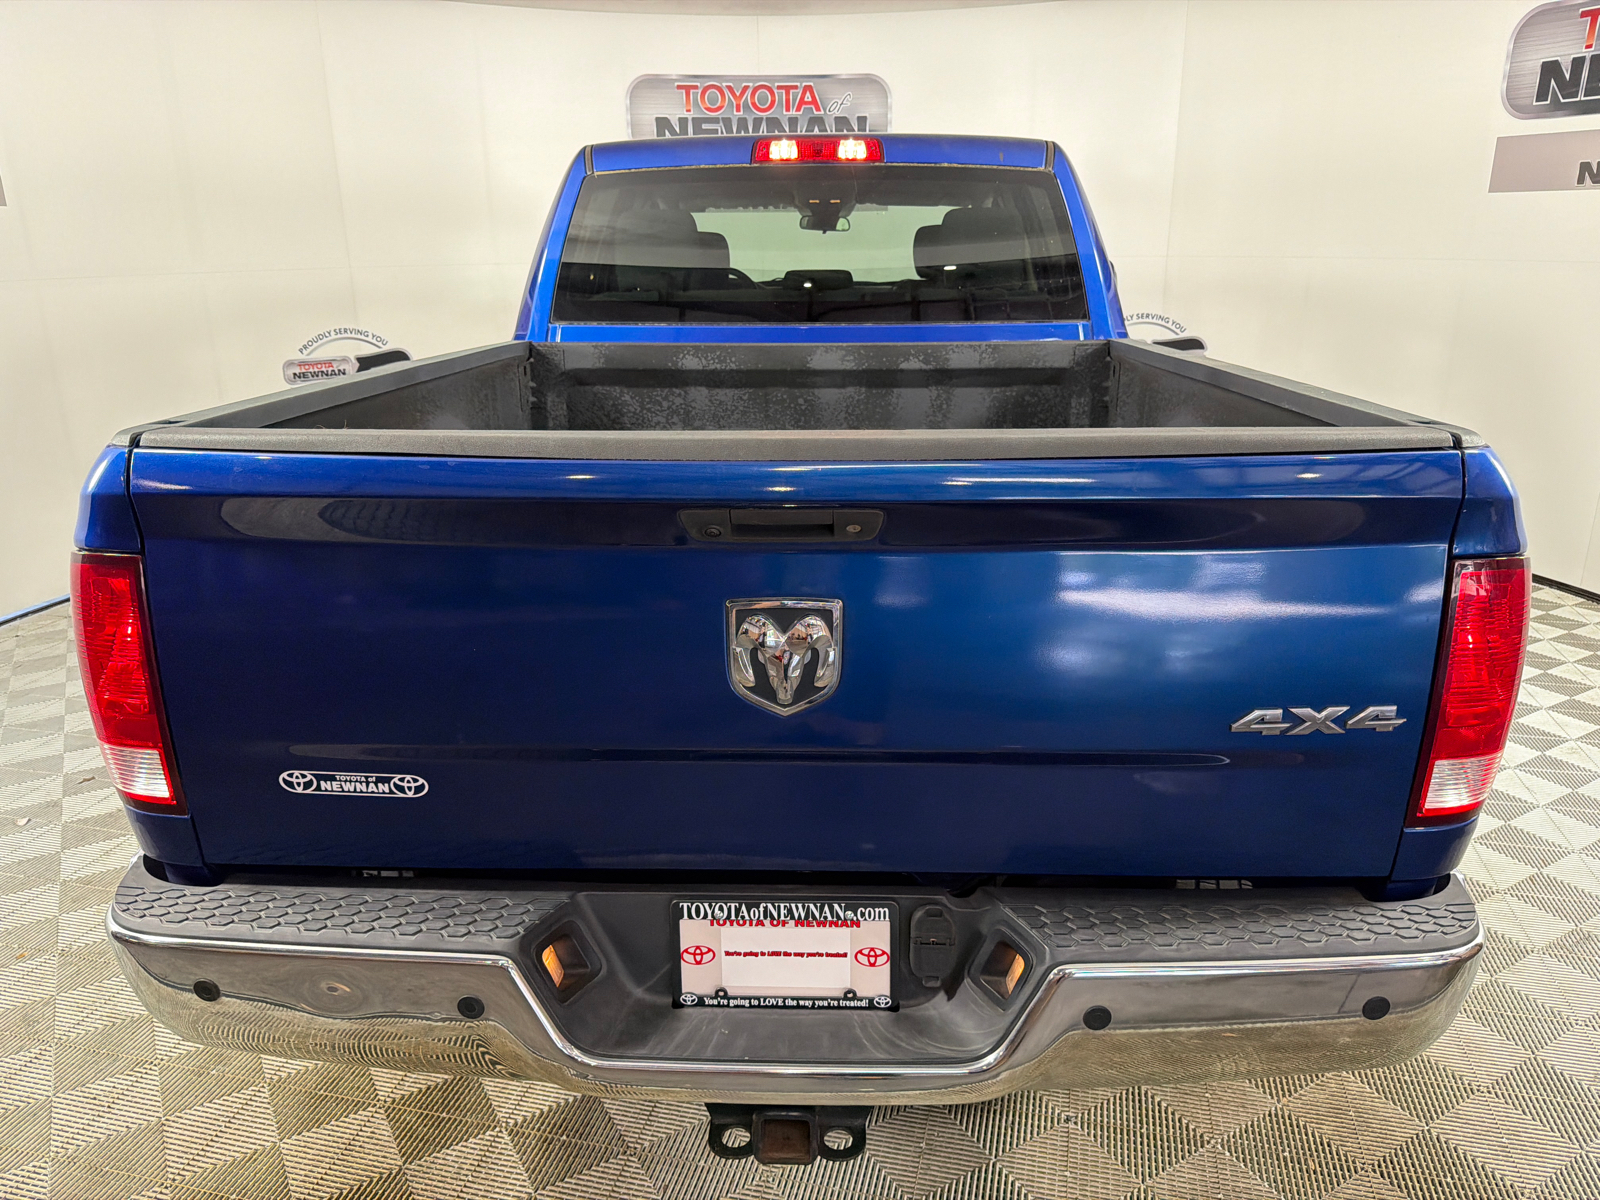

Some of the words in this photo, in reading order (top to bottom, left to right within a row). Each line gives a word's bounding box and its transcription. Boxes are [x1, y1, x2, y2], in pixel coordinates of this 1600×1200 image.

[676, 83, 823, 113] TOYOTA
[827, 93, 851, 113] of
[1136, 312, 1169, 324] SERVING
[1170, 319, 1187, 334] YOU
[298, 330, 332, 355] PROUDLY
[333, 327, 369, 338] SERVING
[371, 333, 388, 346] YOU
[297, 361, 334, 372] TOYOTA
[293, 368, 346, 380] NEWNAN
[320, 780, 389, 793] NEWNAN
[703, 997, 727, 1005] You're
[729, 998, 749, 1007] going
[751, 998, 759, 1006] to
[760, 998, 784, 1006] LOVE
[785, 998, 797, 1006] the
[799, 999, 813, 1008] way
[814, 999, 838, 1008] you're
[839, 998, 868, 1007] treated!
